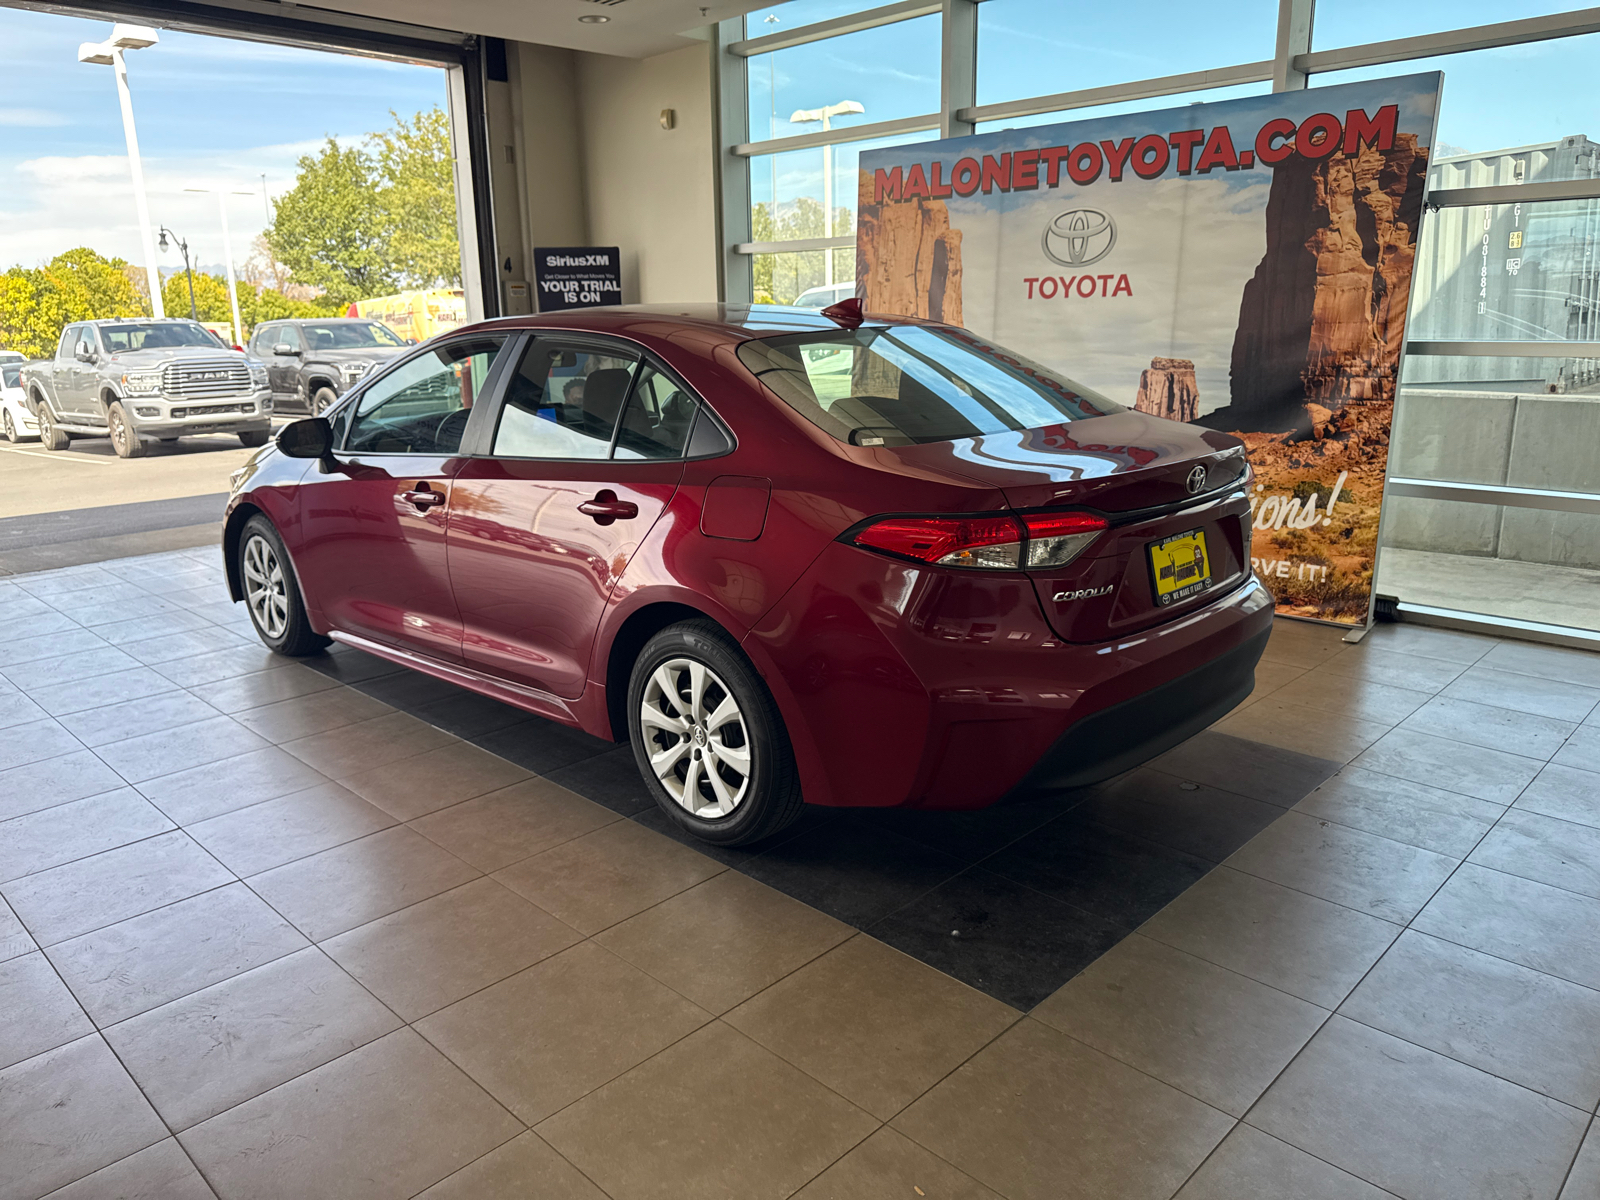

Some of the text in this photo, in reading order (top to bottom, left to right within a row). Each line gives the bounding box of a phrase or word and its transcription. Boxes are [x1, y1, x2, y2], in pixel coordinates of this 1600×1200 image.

[874, 104, 1399, 204] MALONETOYOTA.COM
[504, 257, 512, 273] 4
[546, 255, 610, 267] SiriusXM
[540, 280, 621, 292] YOUR TRIAL
[1023, 273, 1133, 300] TOYOTA
[564, 292, 601, 303] IS ON
[1248, 470, 1348, 530] ions!
[1298, 563, 1327, 583] IT!
[1052, 584, 1114, 602] COROLLA
[1173, 592, 1180, 600] WE
